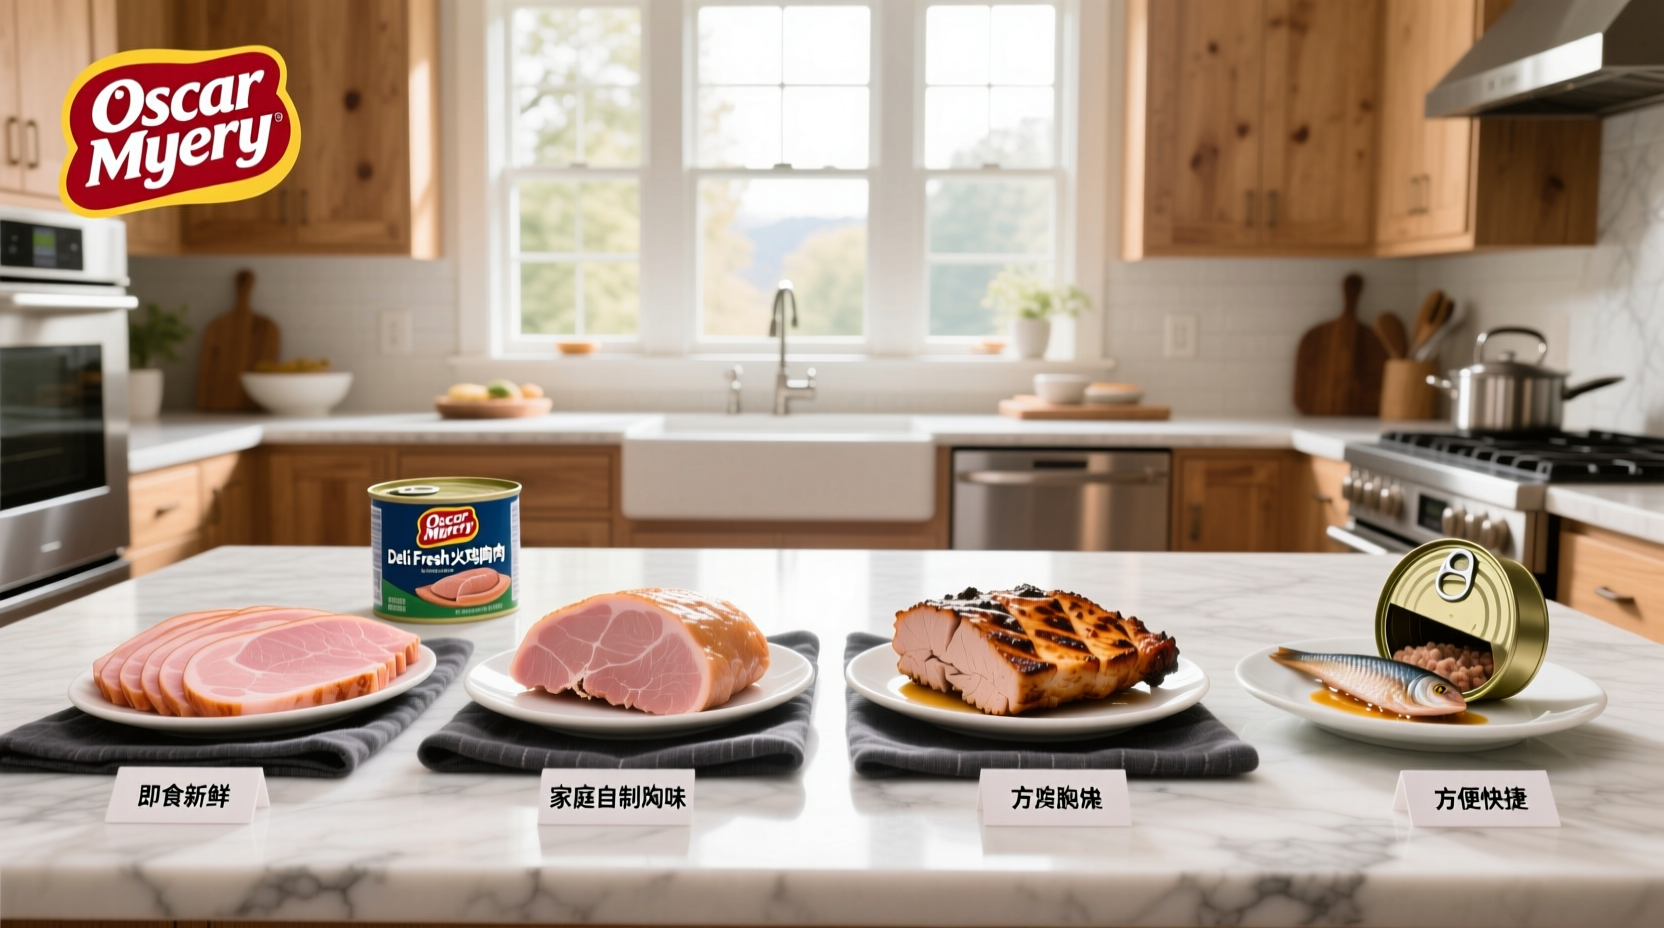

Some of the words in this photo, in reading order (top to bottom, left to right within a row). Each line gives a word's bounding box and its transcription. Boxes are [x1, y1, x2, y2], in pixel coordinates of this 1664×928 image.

[387, 548, 411, 566] Deli
[413, 548, 450, 566] Fresh
[138, 783, 230, 808] 即食新鲜
[1434, 786, 1529, 811] 方便快捷
